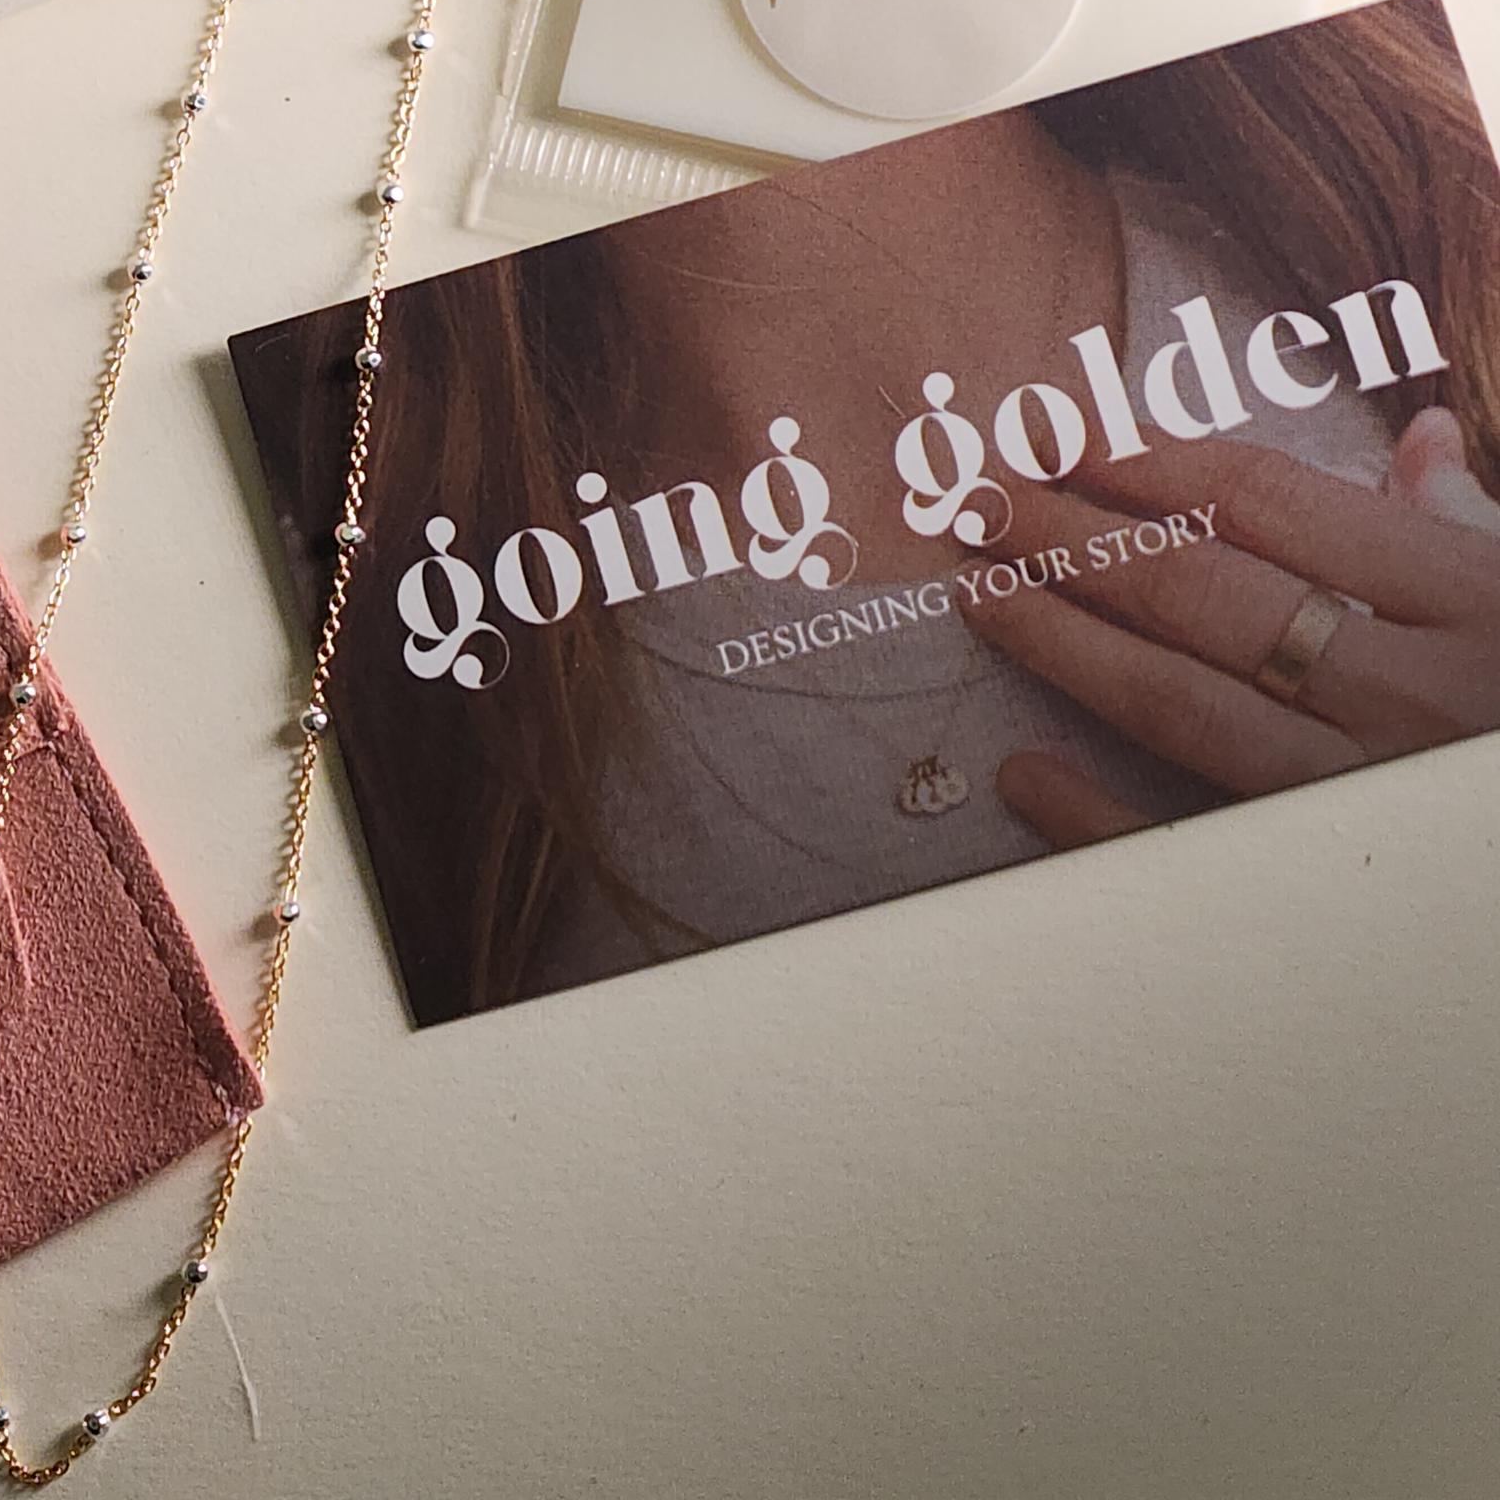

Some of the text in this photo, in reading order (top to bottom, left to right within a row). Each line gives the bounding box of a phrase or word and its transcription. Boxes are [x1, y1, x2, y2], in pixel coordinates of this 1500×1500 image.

[397, 279, 1450, 690] going golden
[716, 502, 1219, 676] DESIGNING YOUR STORY
